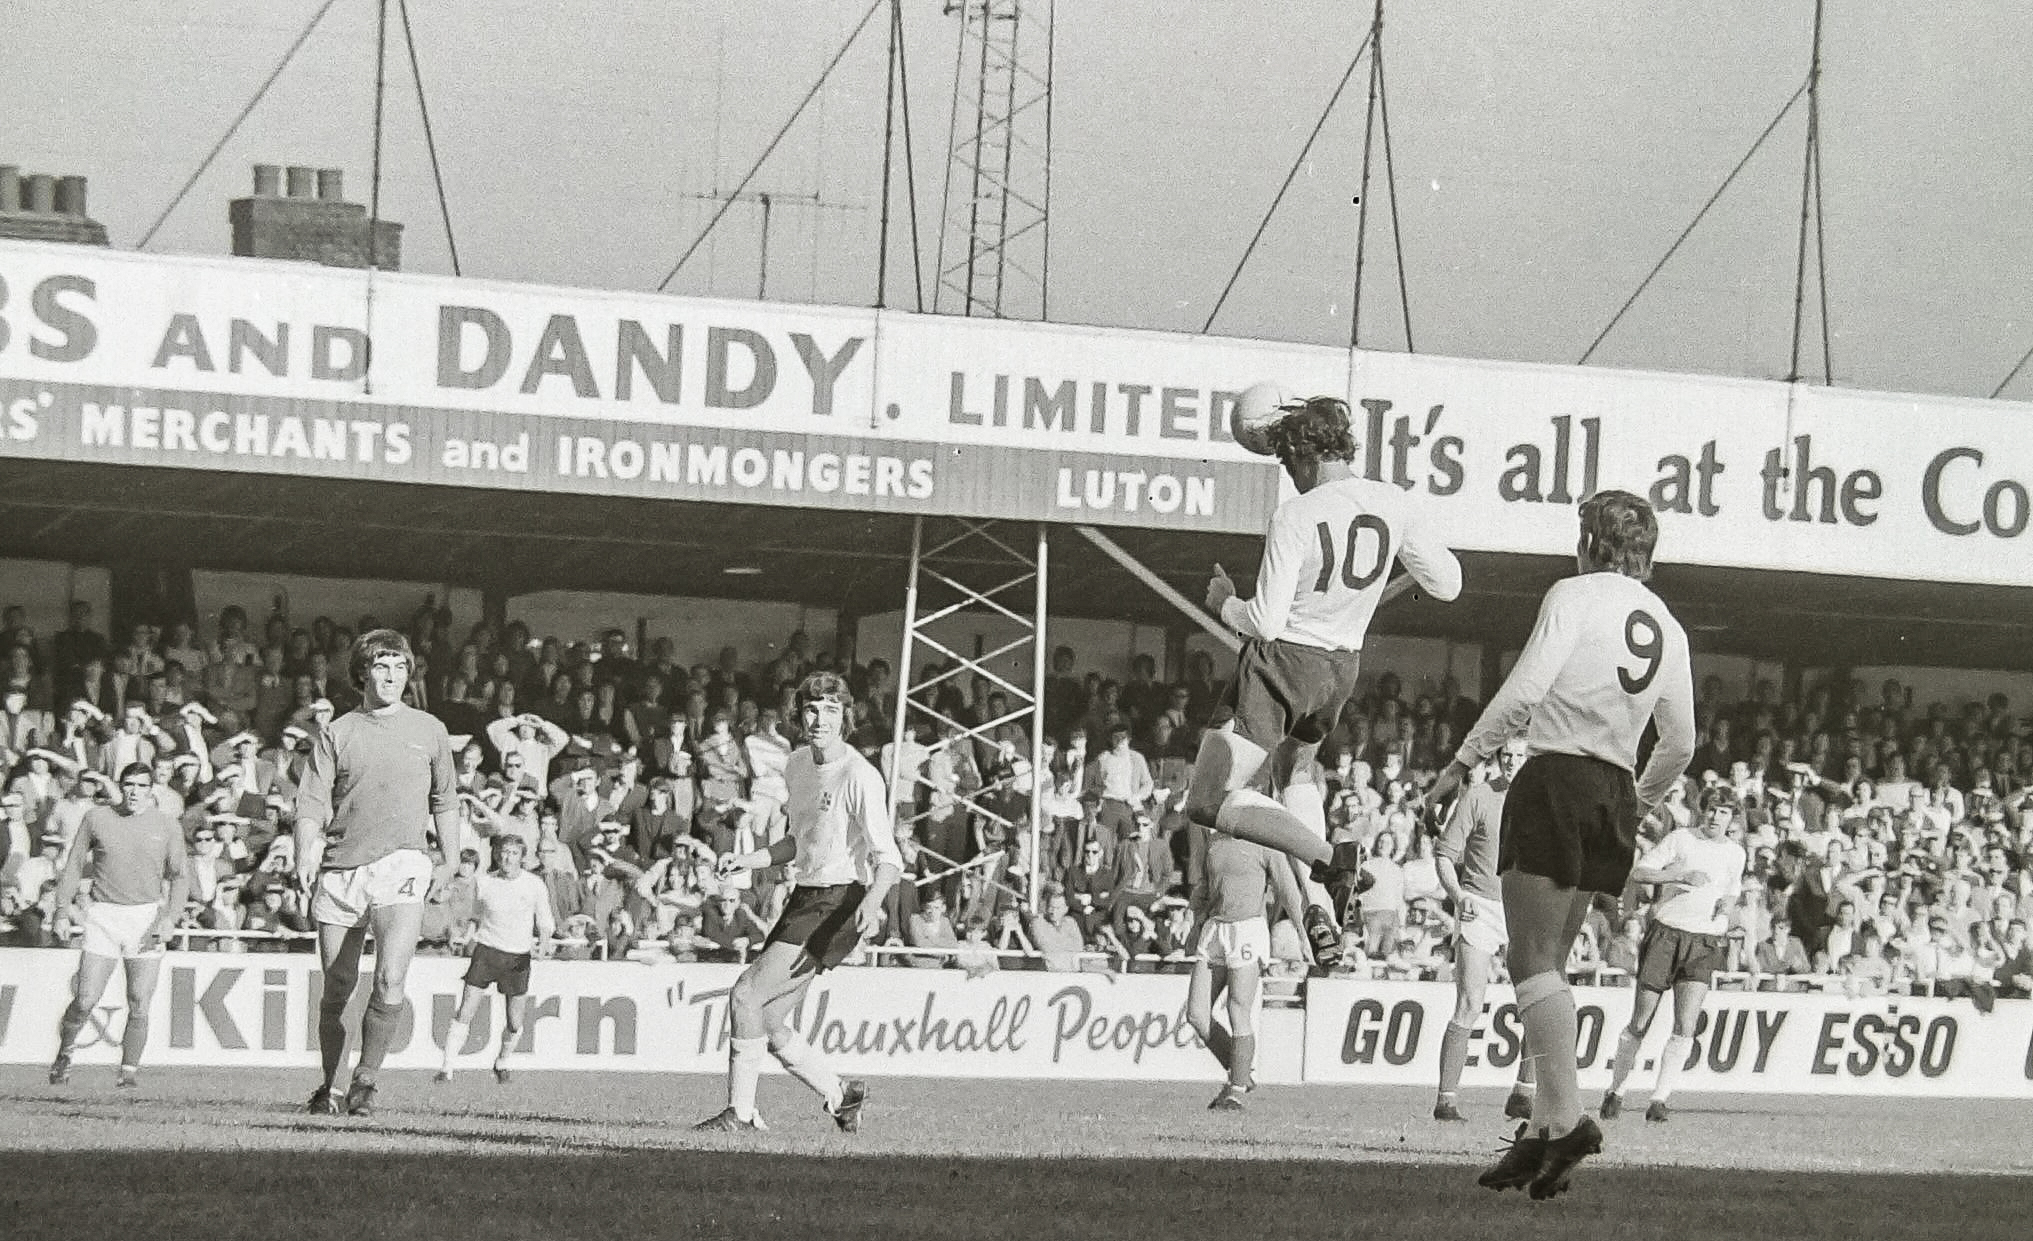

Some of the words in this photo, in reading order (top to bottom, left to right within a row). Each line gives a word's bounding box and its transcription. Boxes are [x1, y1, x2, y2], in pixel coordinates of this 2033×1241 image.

[0, 274, 98, 362] S
[151, 312, 371, 382] AND
[80, 402, 413, 465] MERCHANTS
[441, 432, 530, 474] and
[557, 434, 936, 500] IRONMONGERS
[1056, 468, 1215, 516] LUTON
[1359, 398, 1466, 498] It's
[1498, 414, 1602, 506] all
[1648, 440, 1726, 517] at
[1760, 434, 1883, 527] the
[1921, 446, 2031, 539] Co
[1316, 513, 1392, 593] 10
[1616, 609, 1664, 695] 9
[398, 877, 416, 897] 4
[1241, 943, 1253, 961] 6
[793, 988, 1030, 1058] Vauxhall
[1048, 985, 1207, 1064] Peopl
[1341, 998, 1424, 1067] GO
[1811, 1011, 1958, 1078] ESSO
